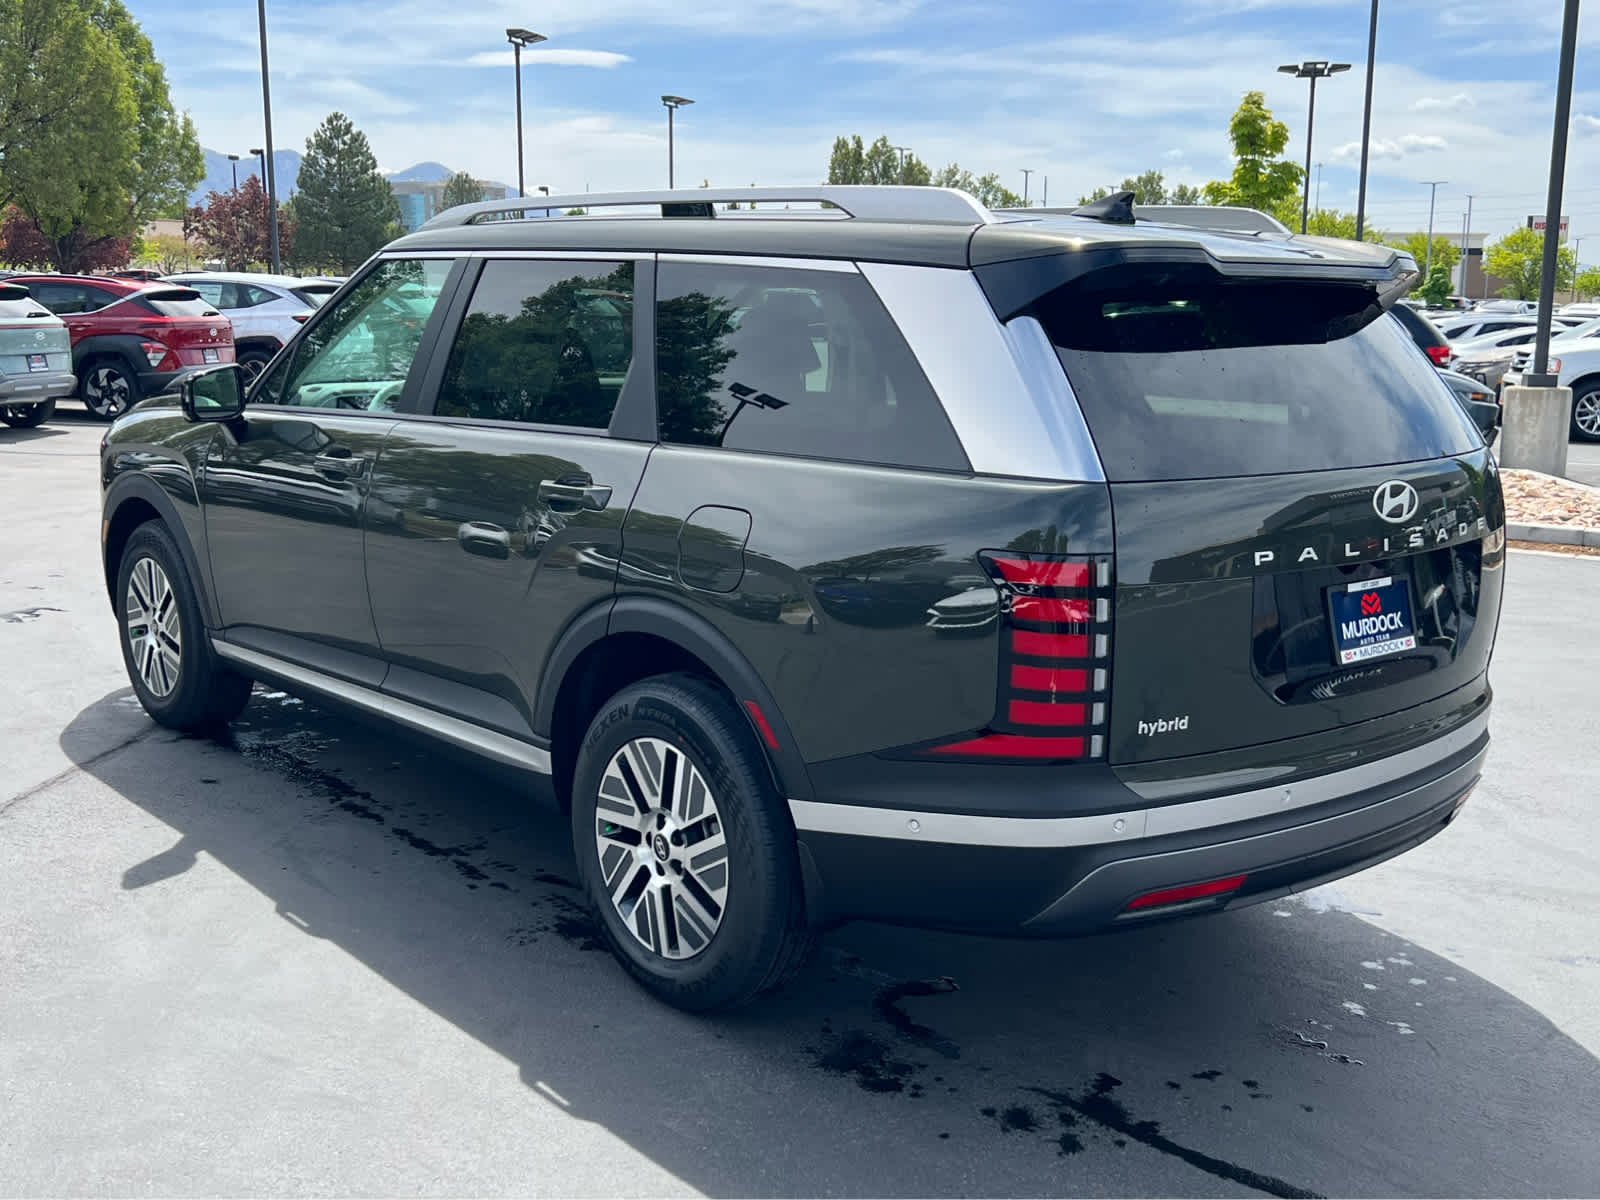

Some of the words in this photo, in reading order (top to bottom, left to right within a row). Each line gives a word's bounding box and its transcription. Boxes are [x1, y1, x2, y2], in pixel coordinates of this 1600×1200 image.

[1254, 517, 1486, 566] PALISADE
[1341, 611, 1404, 640] MURDOCK
[1359, 640, 1400, 657] MURDOCK
[1360, 636, 1375, 645] AUTO
[1375, 633, 1390, 642] TEAM
[1138, 716, 1189, 736] hybrid
